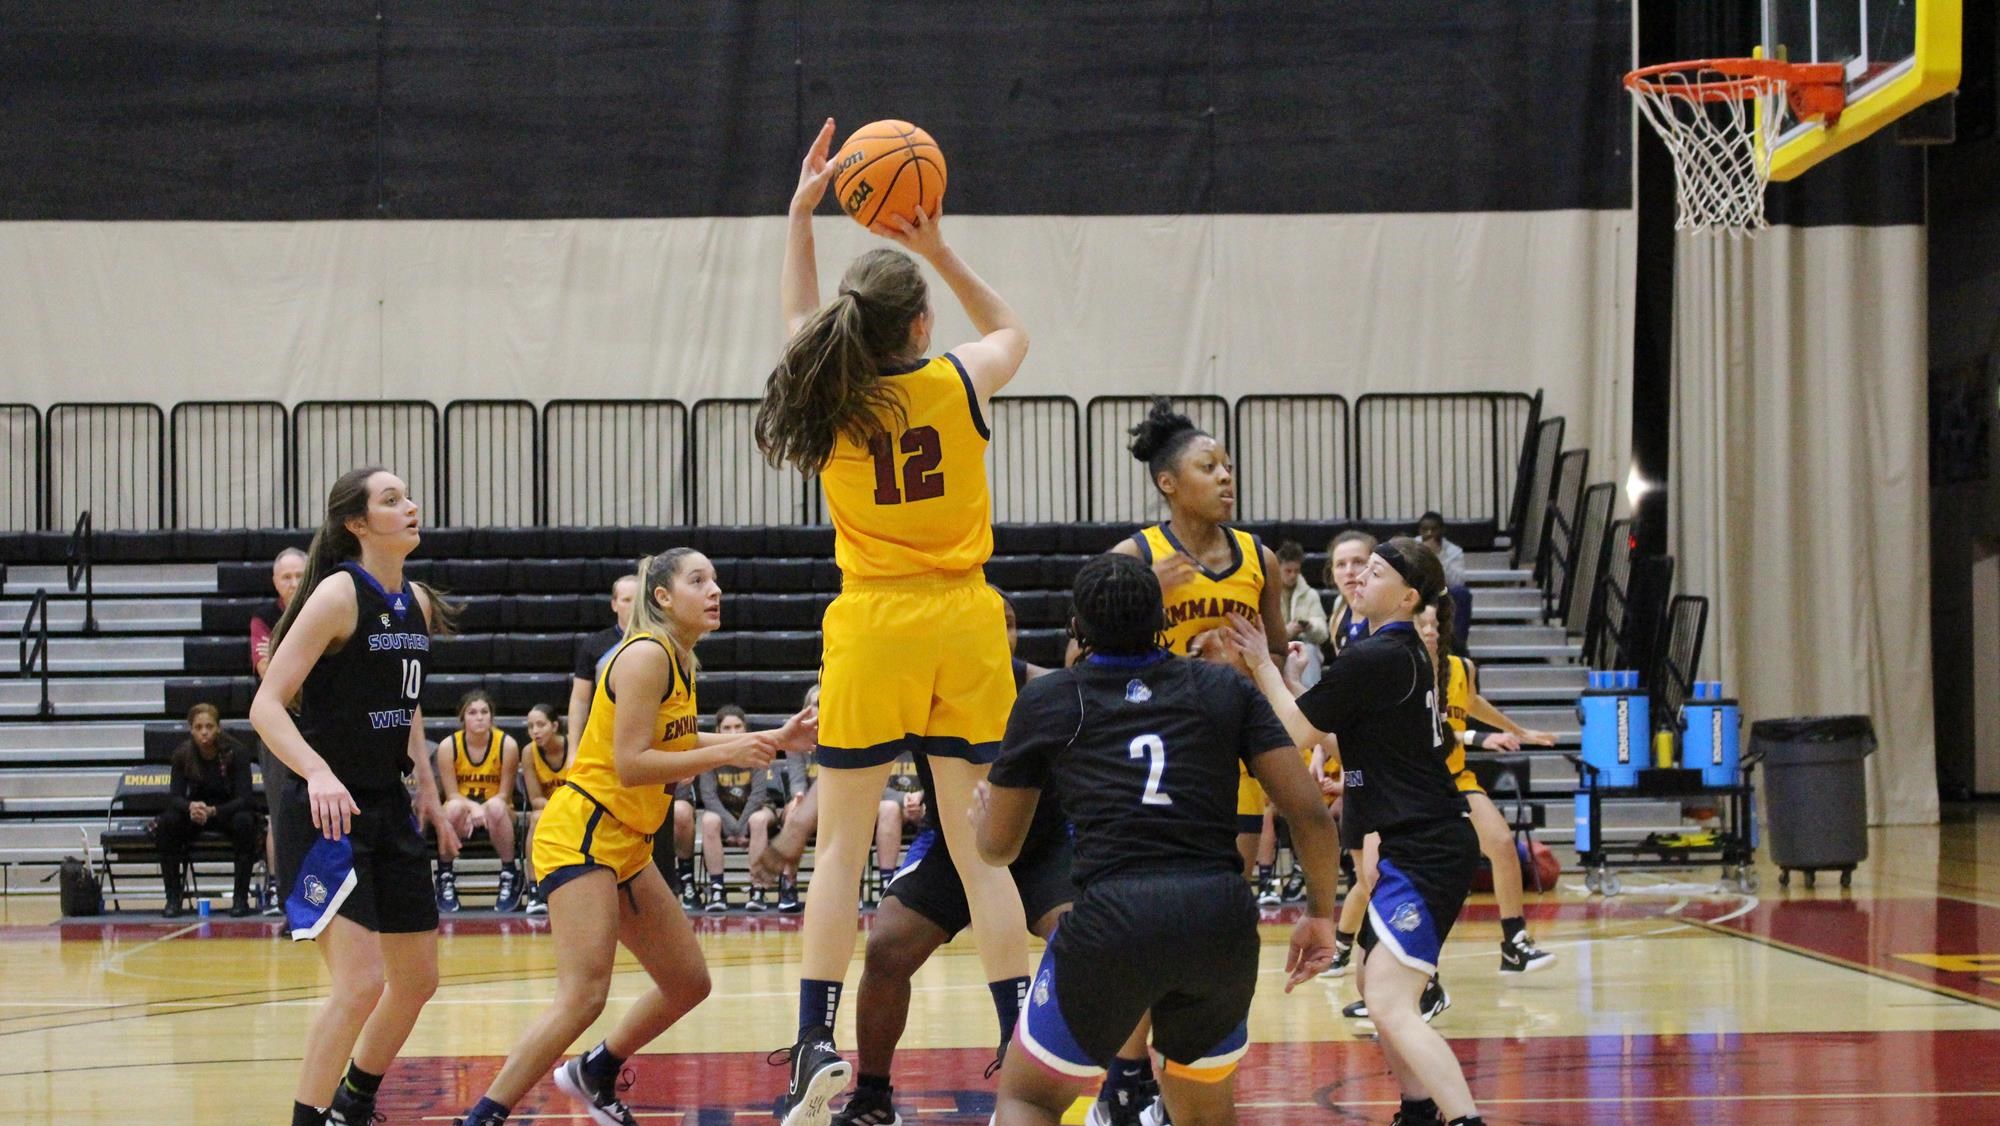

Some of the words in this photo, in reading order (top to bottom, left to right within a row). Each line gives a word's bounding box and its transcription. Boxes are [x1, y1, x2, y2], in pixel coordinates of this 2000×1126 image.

[868, 425, 944, 505] 12
[401, 659, 421, 699] 10
[1129, 734, 1172, 805] 2
